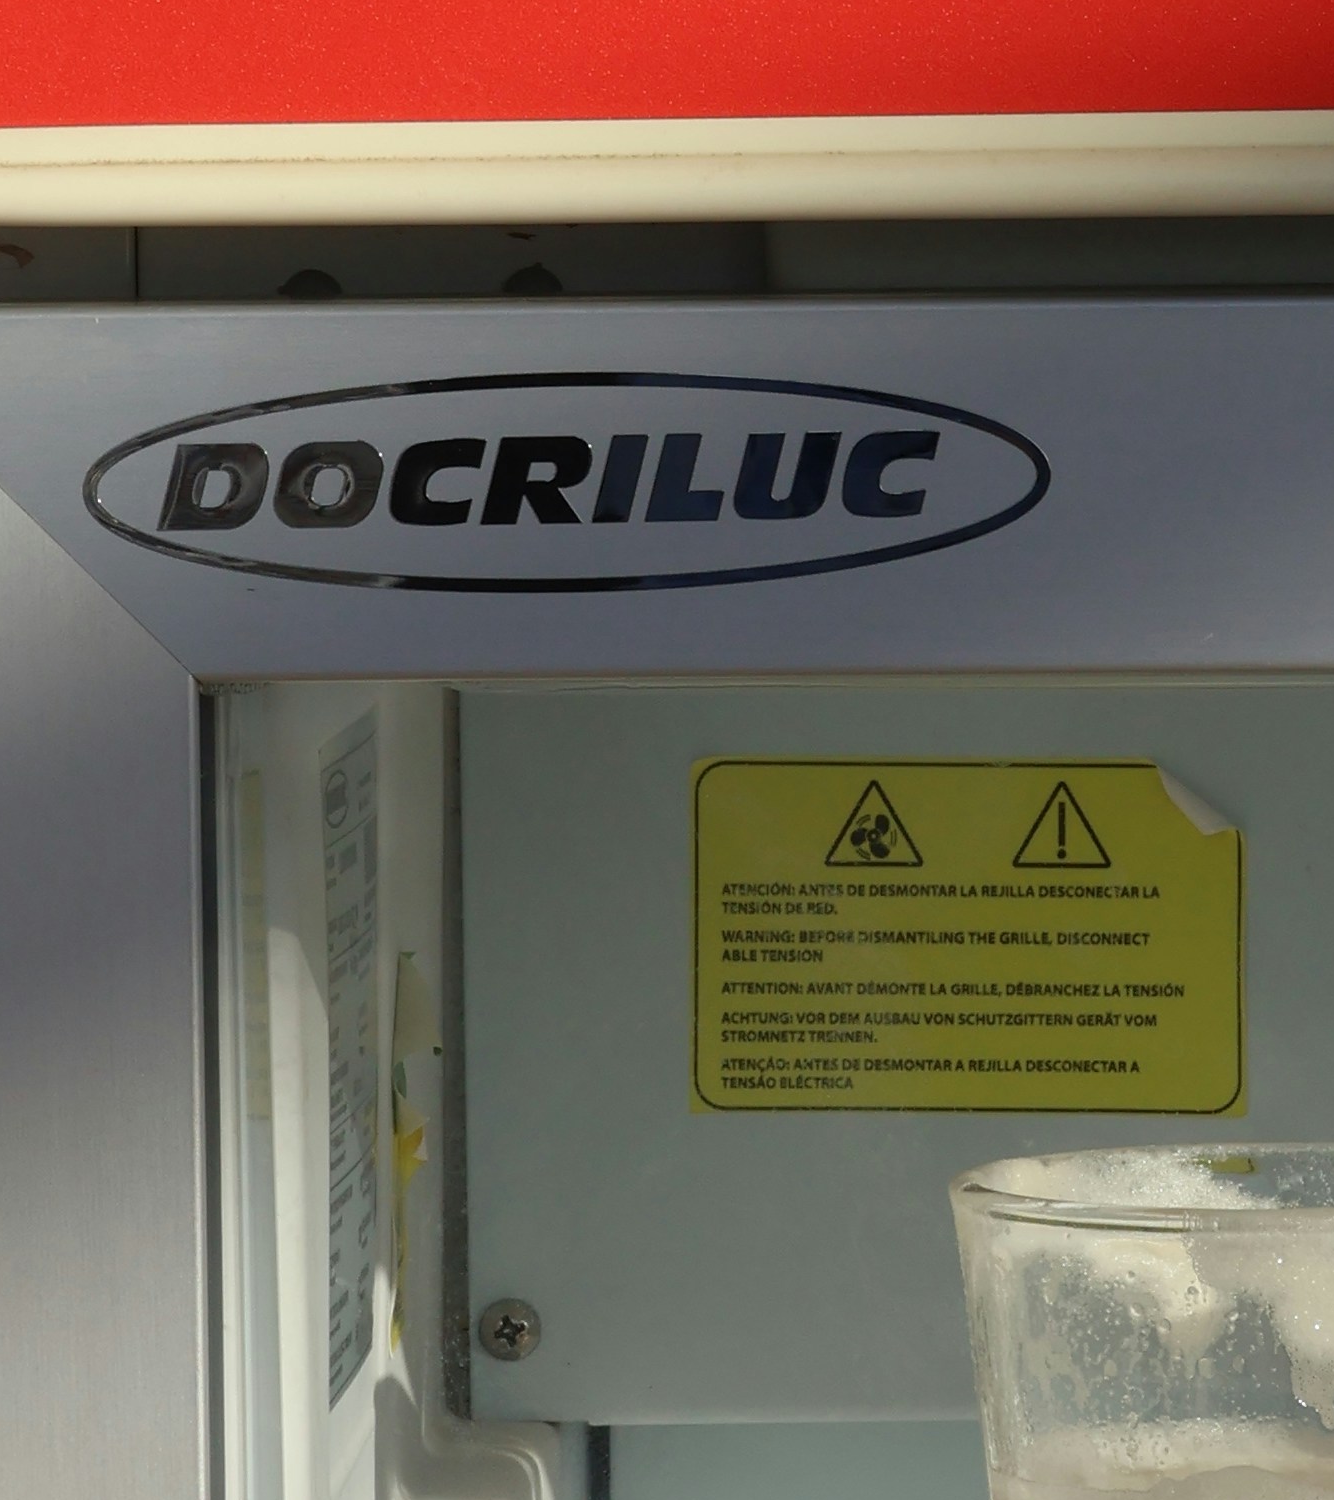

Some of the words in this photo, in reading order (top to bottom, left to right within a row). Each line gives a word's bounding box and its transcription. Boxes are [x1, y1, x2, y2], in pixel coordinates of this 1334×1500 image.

[157, 429, 940, 532] DOCRILUC
[722, 882, 795, 897] ATENCIÓN:
[798, 884, 844, 897] ANTES
[847, 884, 865, 897] DE
[869, 884, 957, 897] DESMONTAR
[960, 885, 977, 898] LA
[981, 885, 1035, 898] REJILLA
[1038, 885, 1139, 899] DESCONECTAR
[1143, 886, 1160, 898] LA
[722, 901, 782, 915] TENSIÓN
[785, 903, 803, 915] DE
[807, 902, 838, 915] RED.
[722, 930, 795, 943] WARNING:
[799, 930, 854, 944] BEFORE
[858, 930, 965, 945] DISMANTILING
[969, 932, 995, 944] THE
[999, 932, 1053, 946] GRILLE,
[1057, 932, 1151, 946] DISCONNECT
[722, 949, 757, 962] ABLE
[760, 949, 823, 962] TENSION
[722, 982, 803, 995] ATTENTION:
[806, 982, 853, 995] AVANT
[857, 980, 926, 996] DÉMONTE
[930, 983, 947, 996] LA
[951, 983, 1002, 997] GRILLE,
[1006, 982, 1100, 997] DÉBRANCHEZ
[1104, 984, 1121, 997] LA
[1124, 982, 1185, 998] TENSIÓN
[722, 1012, 793, 1025] ACHTUNG:
[796, 1012, 826, 1025] VOR
[829, 1012, 859, 1025] DEM
[864, 1012, 920, 1026] AUSBAU
[924, 1013, 955, 1025] VON
[958, 1013, 1073, 1026] SCHUTZGITTERN
[1076, 1011, 1121, 1027] GERÄT
[1124, 1014, 1157, 1027] VOM
[722, 1030, 805, 1043] STROMNETZ
[809, 1030, 878, 1044] TRENNEN.
[793, 1058, 838, 1071] ANTES
[842, 1058, 860, 1071] DE
[864, 1058, 950, 1072] DESMONTAR
[954, 1060, 965, 1072] A
[969, 1060, 1022, 1073] REJILLA
[1026, 1060, 1127, 1073] DESCONECTAR
[1130, 1060, 1141, 1073] A
